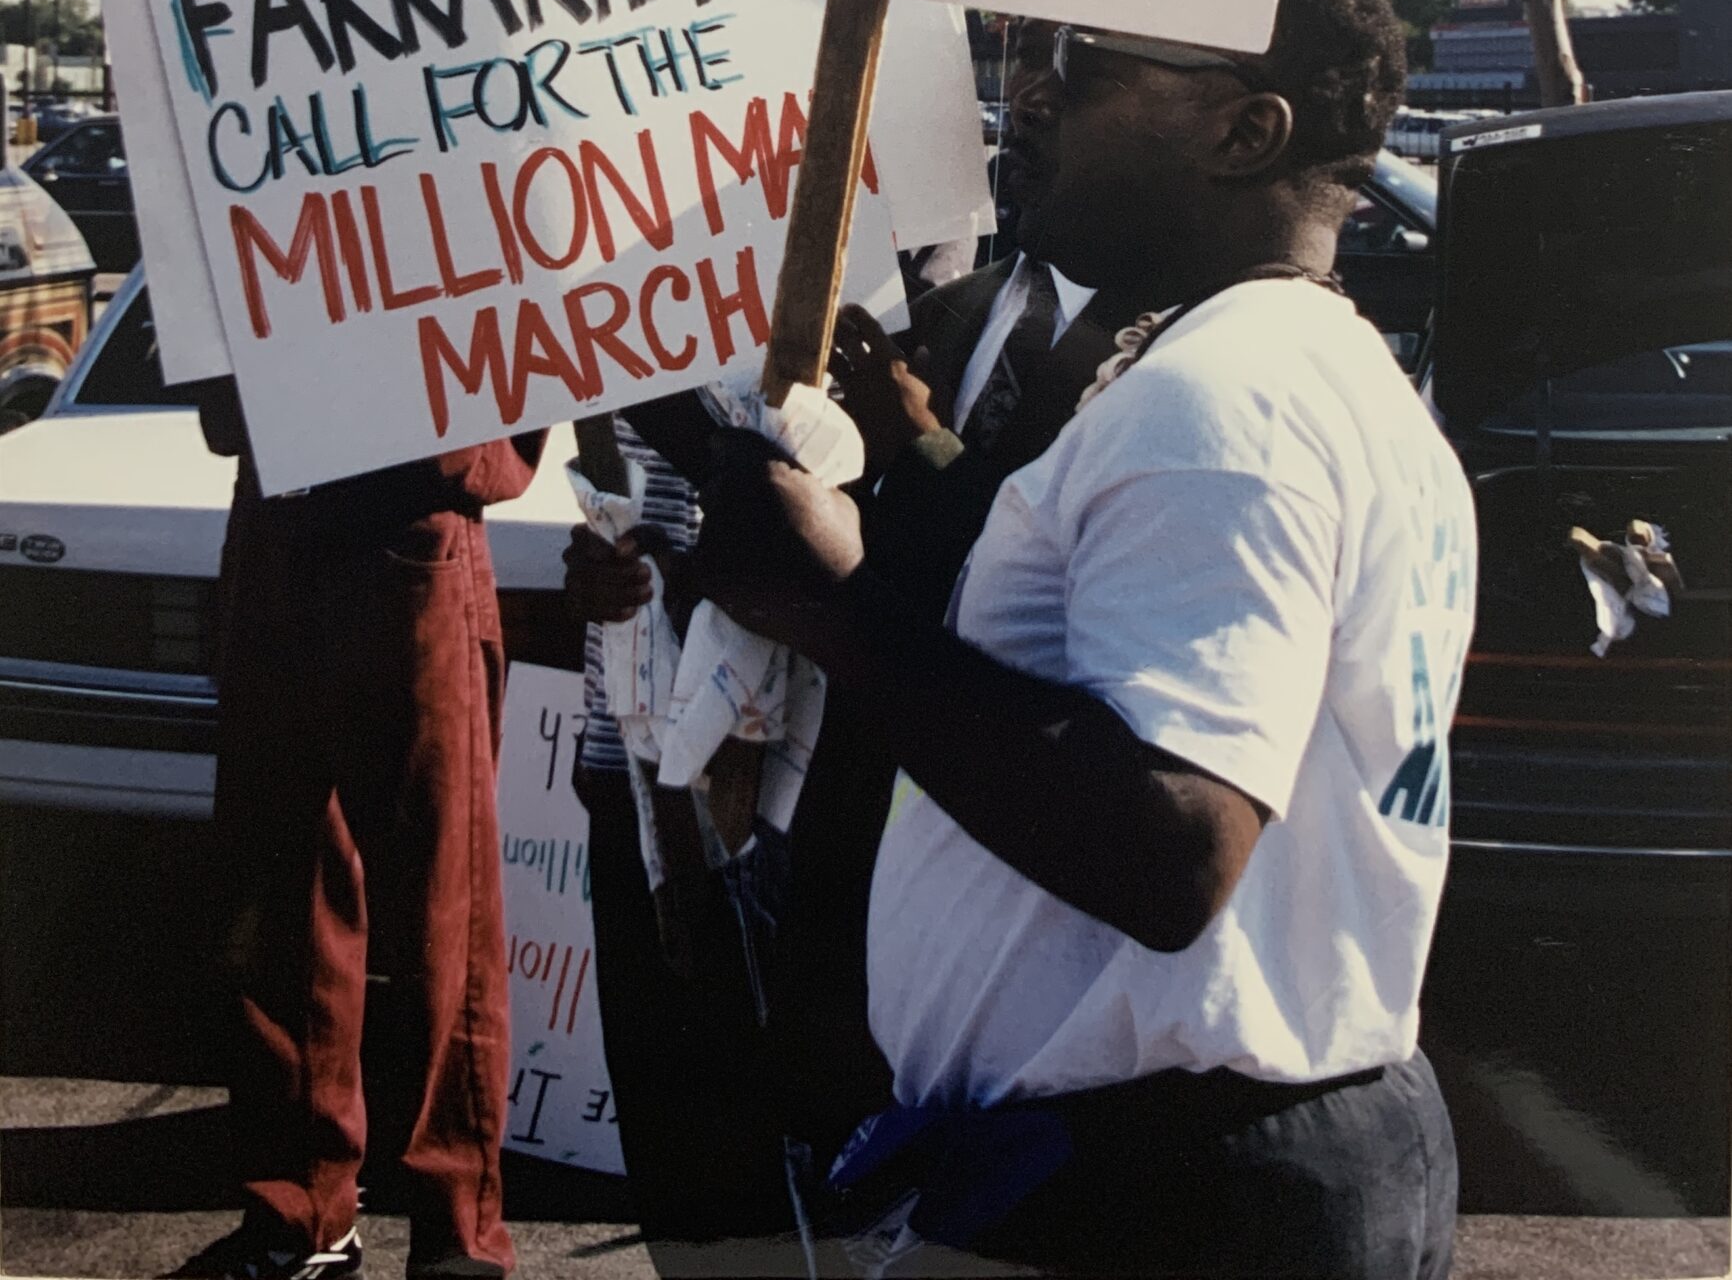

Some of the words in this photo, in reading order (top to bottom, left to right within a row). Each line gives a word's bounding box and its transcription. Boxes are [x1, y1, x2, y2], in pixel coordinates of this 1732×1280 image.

[207, 80, 422, 194] CALL
[422, 37, 592, 154] FOR
[573, 12, 746, 117] THE
[229, 128, 676, 340] MILLION
[416, 245, 773, 439] MARCH
